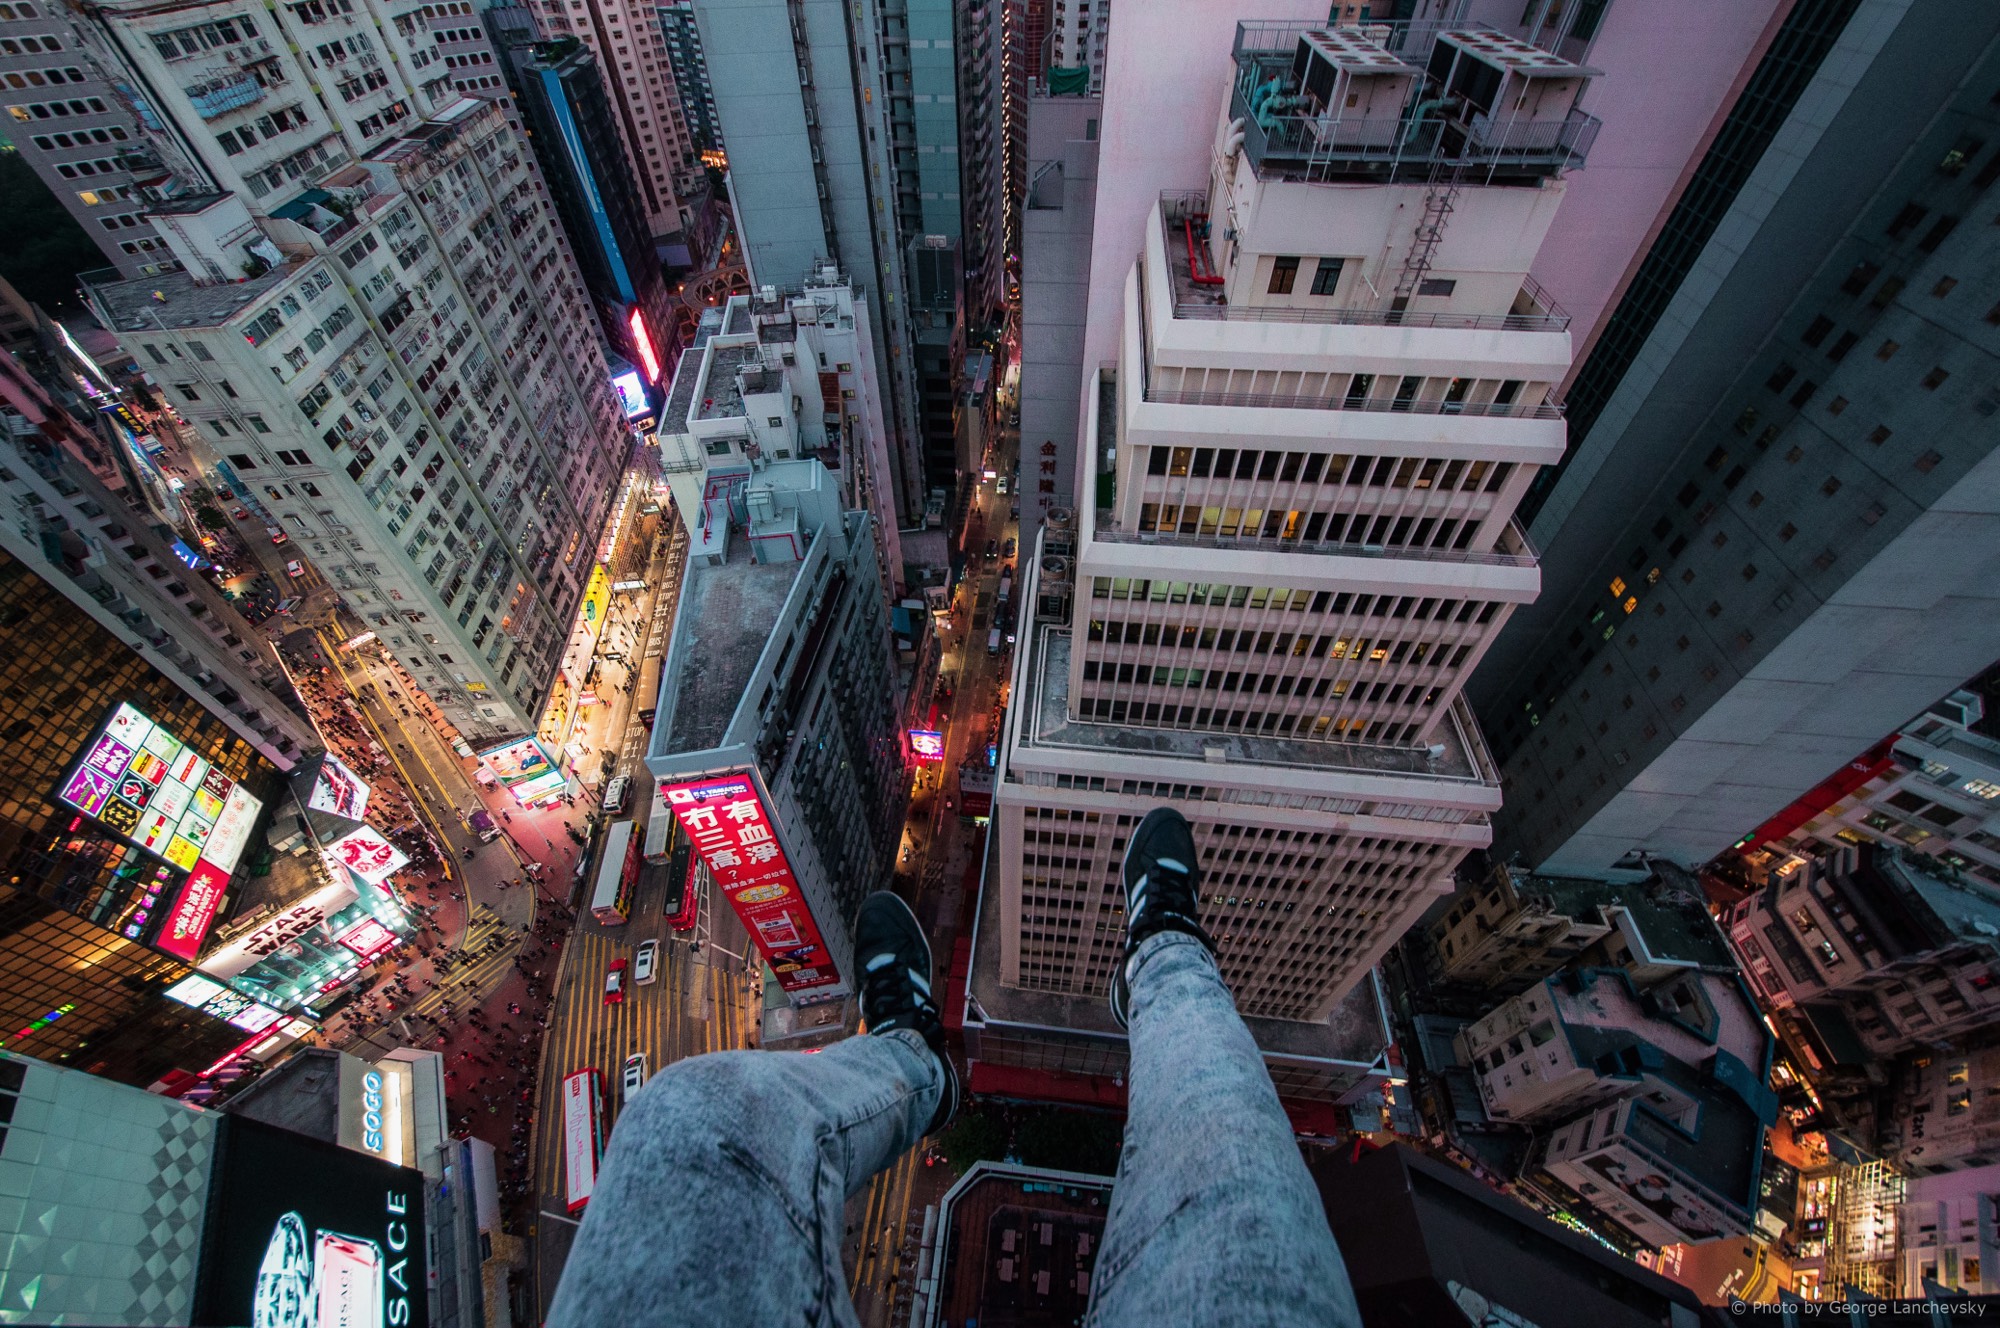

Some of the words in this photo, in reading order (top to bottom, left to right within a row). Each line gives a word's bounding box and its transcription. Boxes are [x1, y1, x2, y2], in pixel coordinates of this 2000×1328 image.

[117, 407, 144, 433] IKEA
[674, 532, 684, 540] BUS
[662, 581, 674, 589] BUS
[658, 592, 674, 600] STOP
[648, 638, 662, 646] BUS
[625, 728, 644, 738] STOP
[88, 747, 110, 770] THAI
[622, 742, 638, 758] 巴士
[722, 798, 780, 866] 有血淨
[196, 885, 215, 913] PARTY
[244, 906, 316, 951] STAR
[251, 910, 324, 956] WARS
[321, 980, 340, 992] 126
[364, 1072, 384, 1152] SOGO
